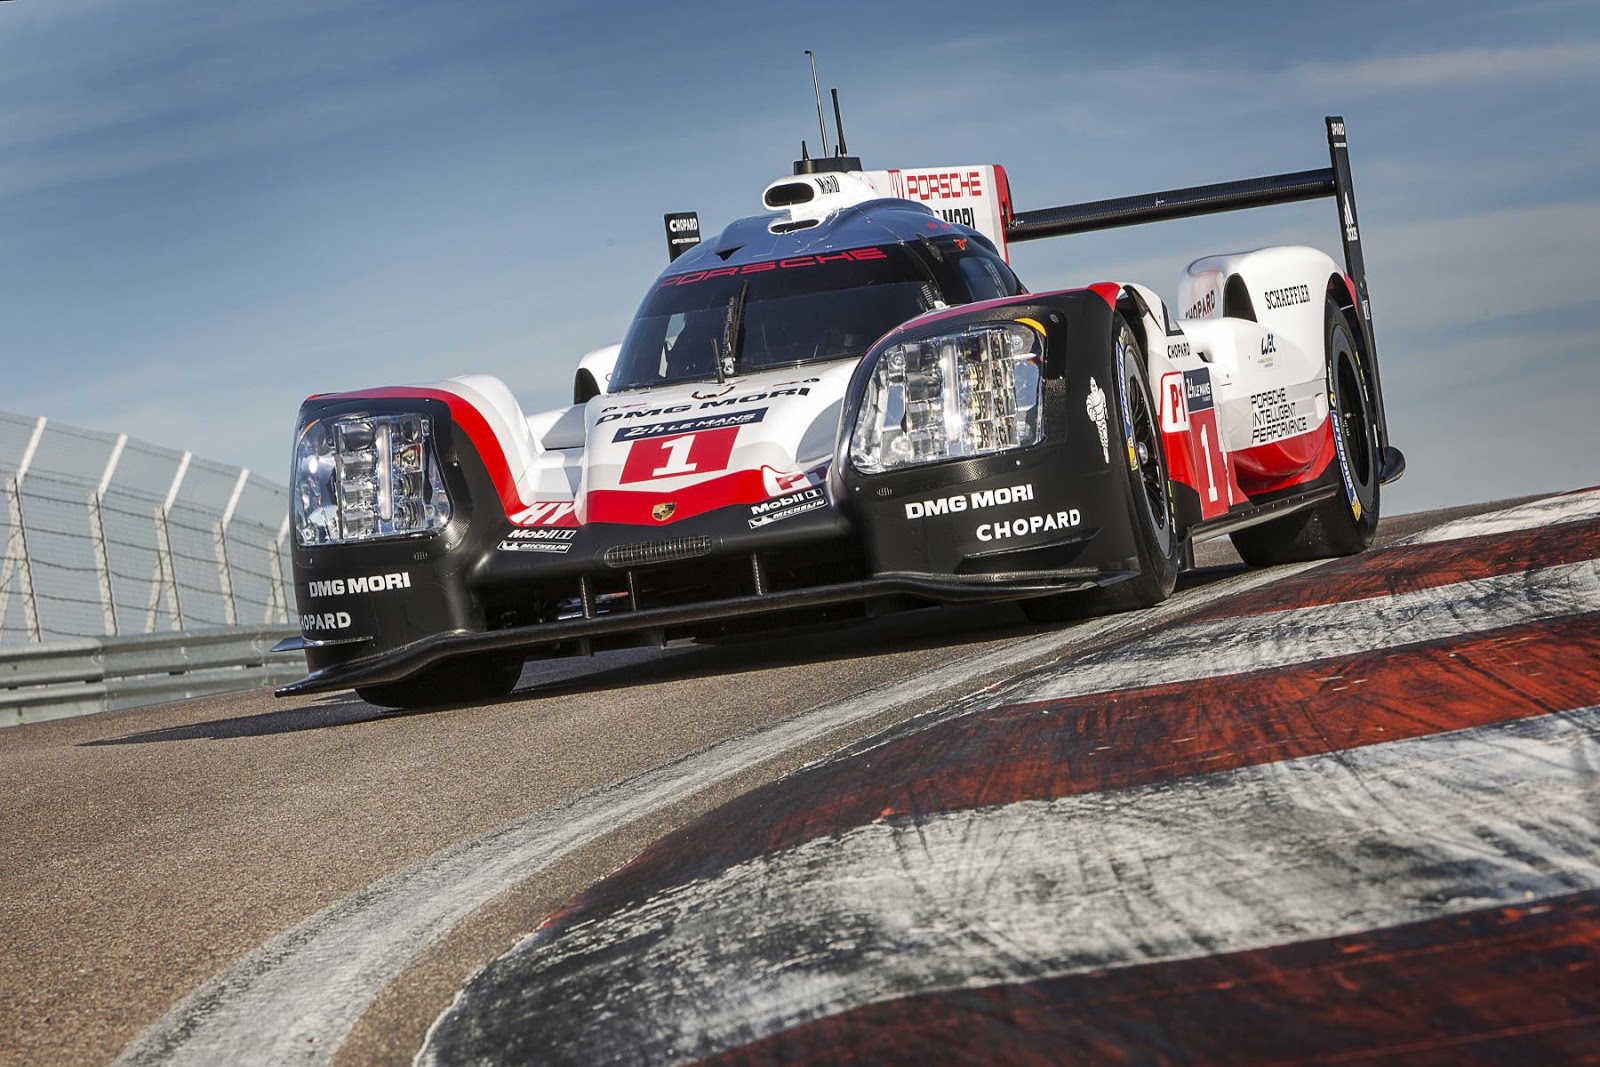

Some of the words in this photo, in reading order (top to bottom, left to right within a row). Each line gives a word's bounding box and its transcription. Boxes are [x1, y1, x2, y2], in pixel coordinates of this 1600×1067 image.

[906, 171, 982, 201] PORSCHE
[656, 247, 887, 291] PORSCHE
[1264, 284, 1311, 310] SCHAEFFLER
[1167, 342, 1191, 359] CHOPARD
[595, 404, 692, 427] DMG
[699, 387, 811, 410] MORI
[1169, 383, 1187, 424] P1
[1250, 387, 1287, 410] PORSCHE
[1252, 402, 1297, 428] INTELLIGENT
[1251, 416, 1308, 445] PERFORMANCE
[652, 434, 698, 477] 1
[1200, 423, 1218, 503] 1
[750, 493, 805, 515] Mobil
[772, 499, 825, 520] MICHELIN
[904, 495, 967, 519] DMG
[971, 483, 1034, 509] MORI
[507, 529, 560, 539] Mobil
[976, 509, 1081, 542] CHOPARD
[520, 543, 569, 551] MICHELIN
[309, 580, 345, 598] DMG
[347, 571, 411, 594] MORI
